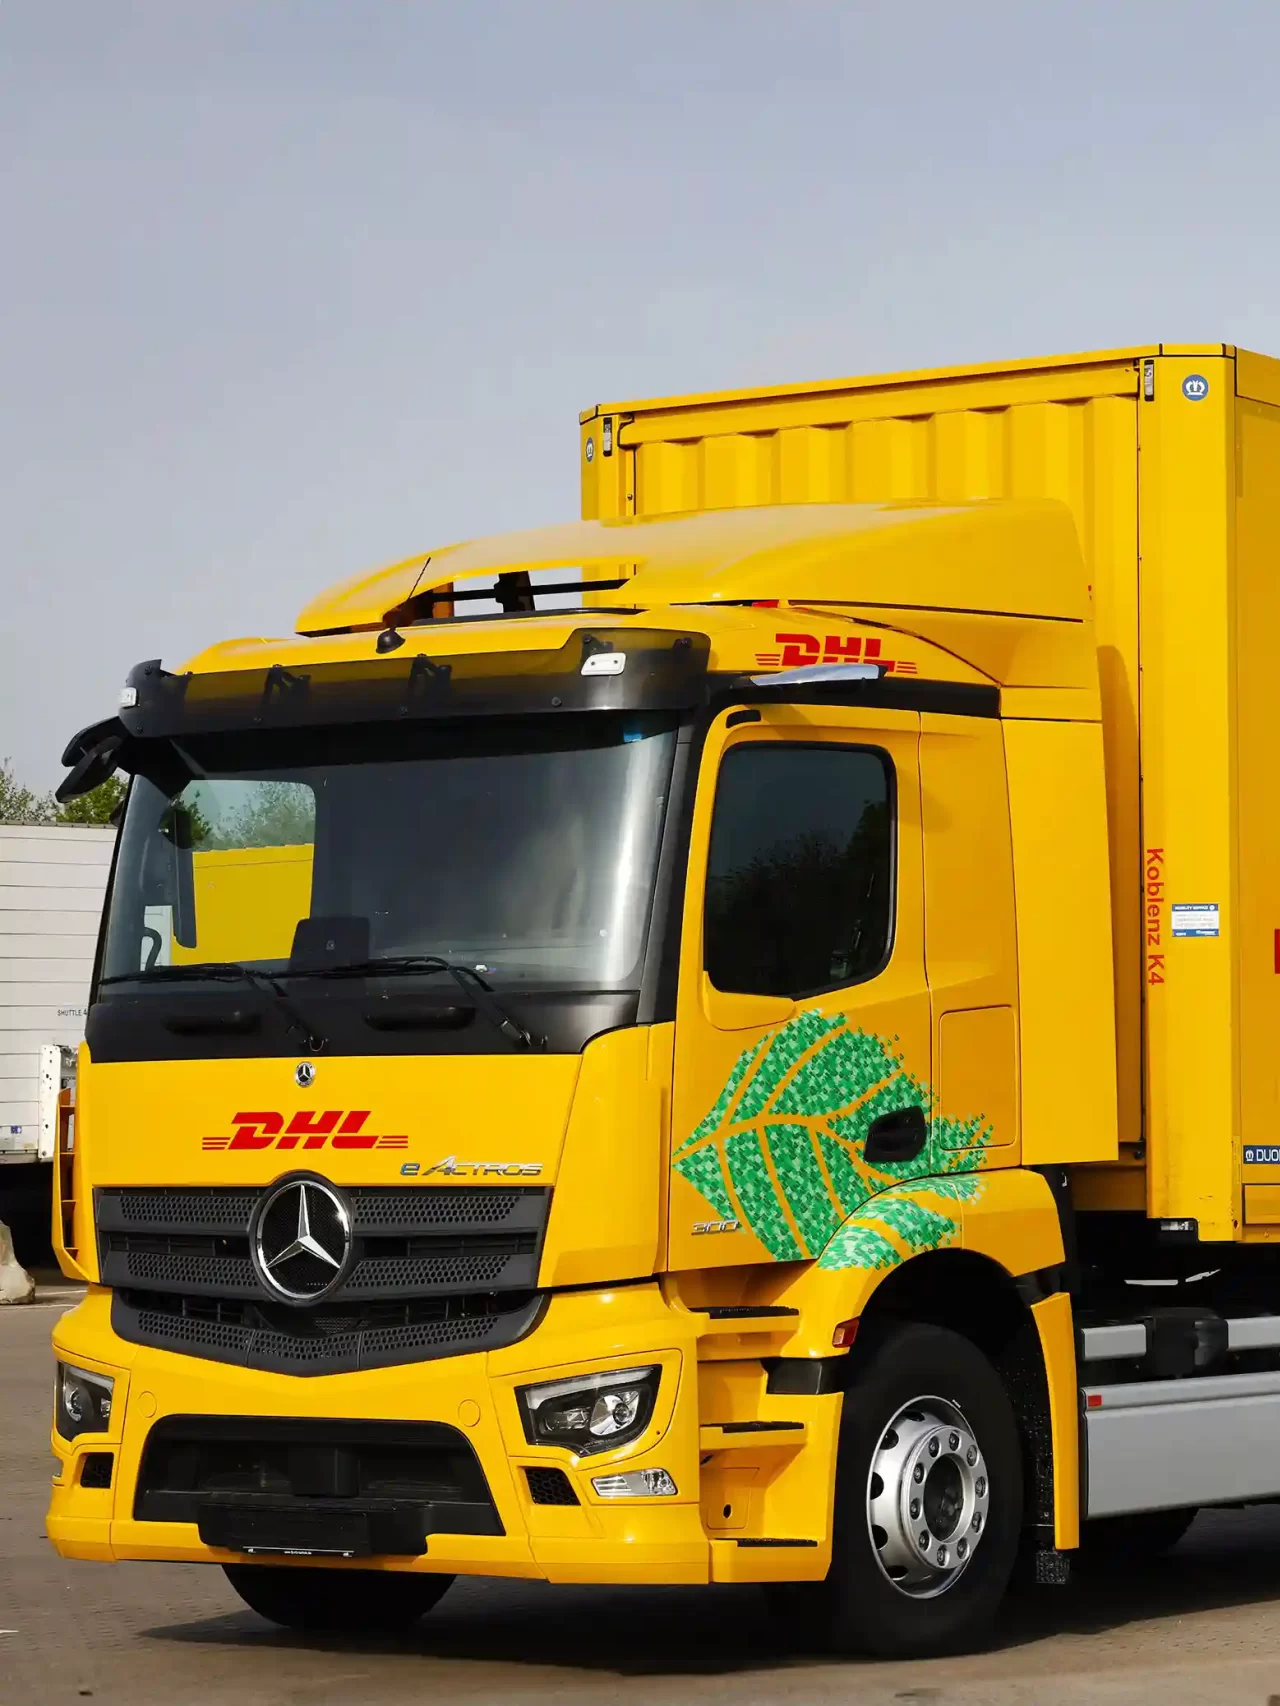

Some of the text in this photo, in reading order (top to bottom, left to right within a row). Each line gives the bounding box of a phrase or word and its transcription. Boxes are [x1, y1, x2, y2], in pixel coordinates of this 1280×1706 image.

[776, 633, 895, 673] DHL
[1147, 848, 1165, 986] Koblenz K4
[57, 1009, 82, 1017] SHUTTLE
[228, 1110, 380, 1150] DHL
[691, 1219, 739, 1235] 300
